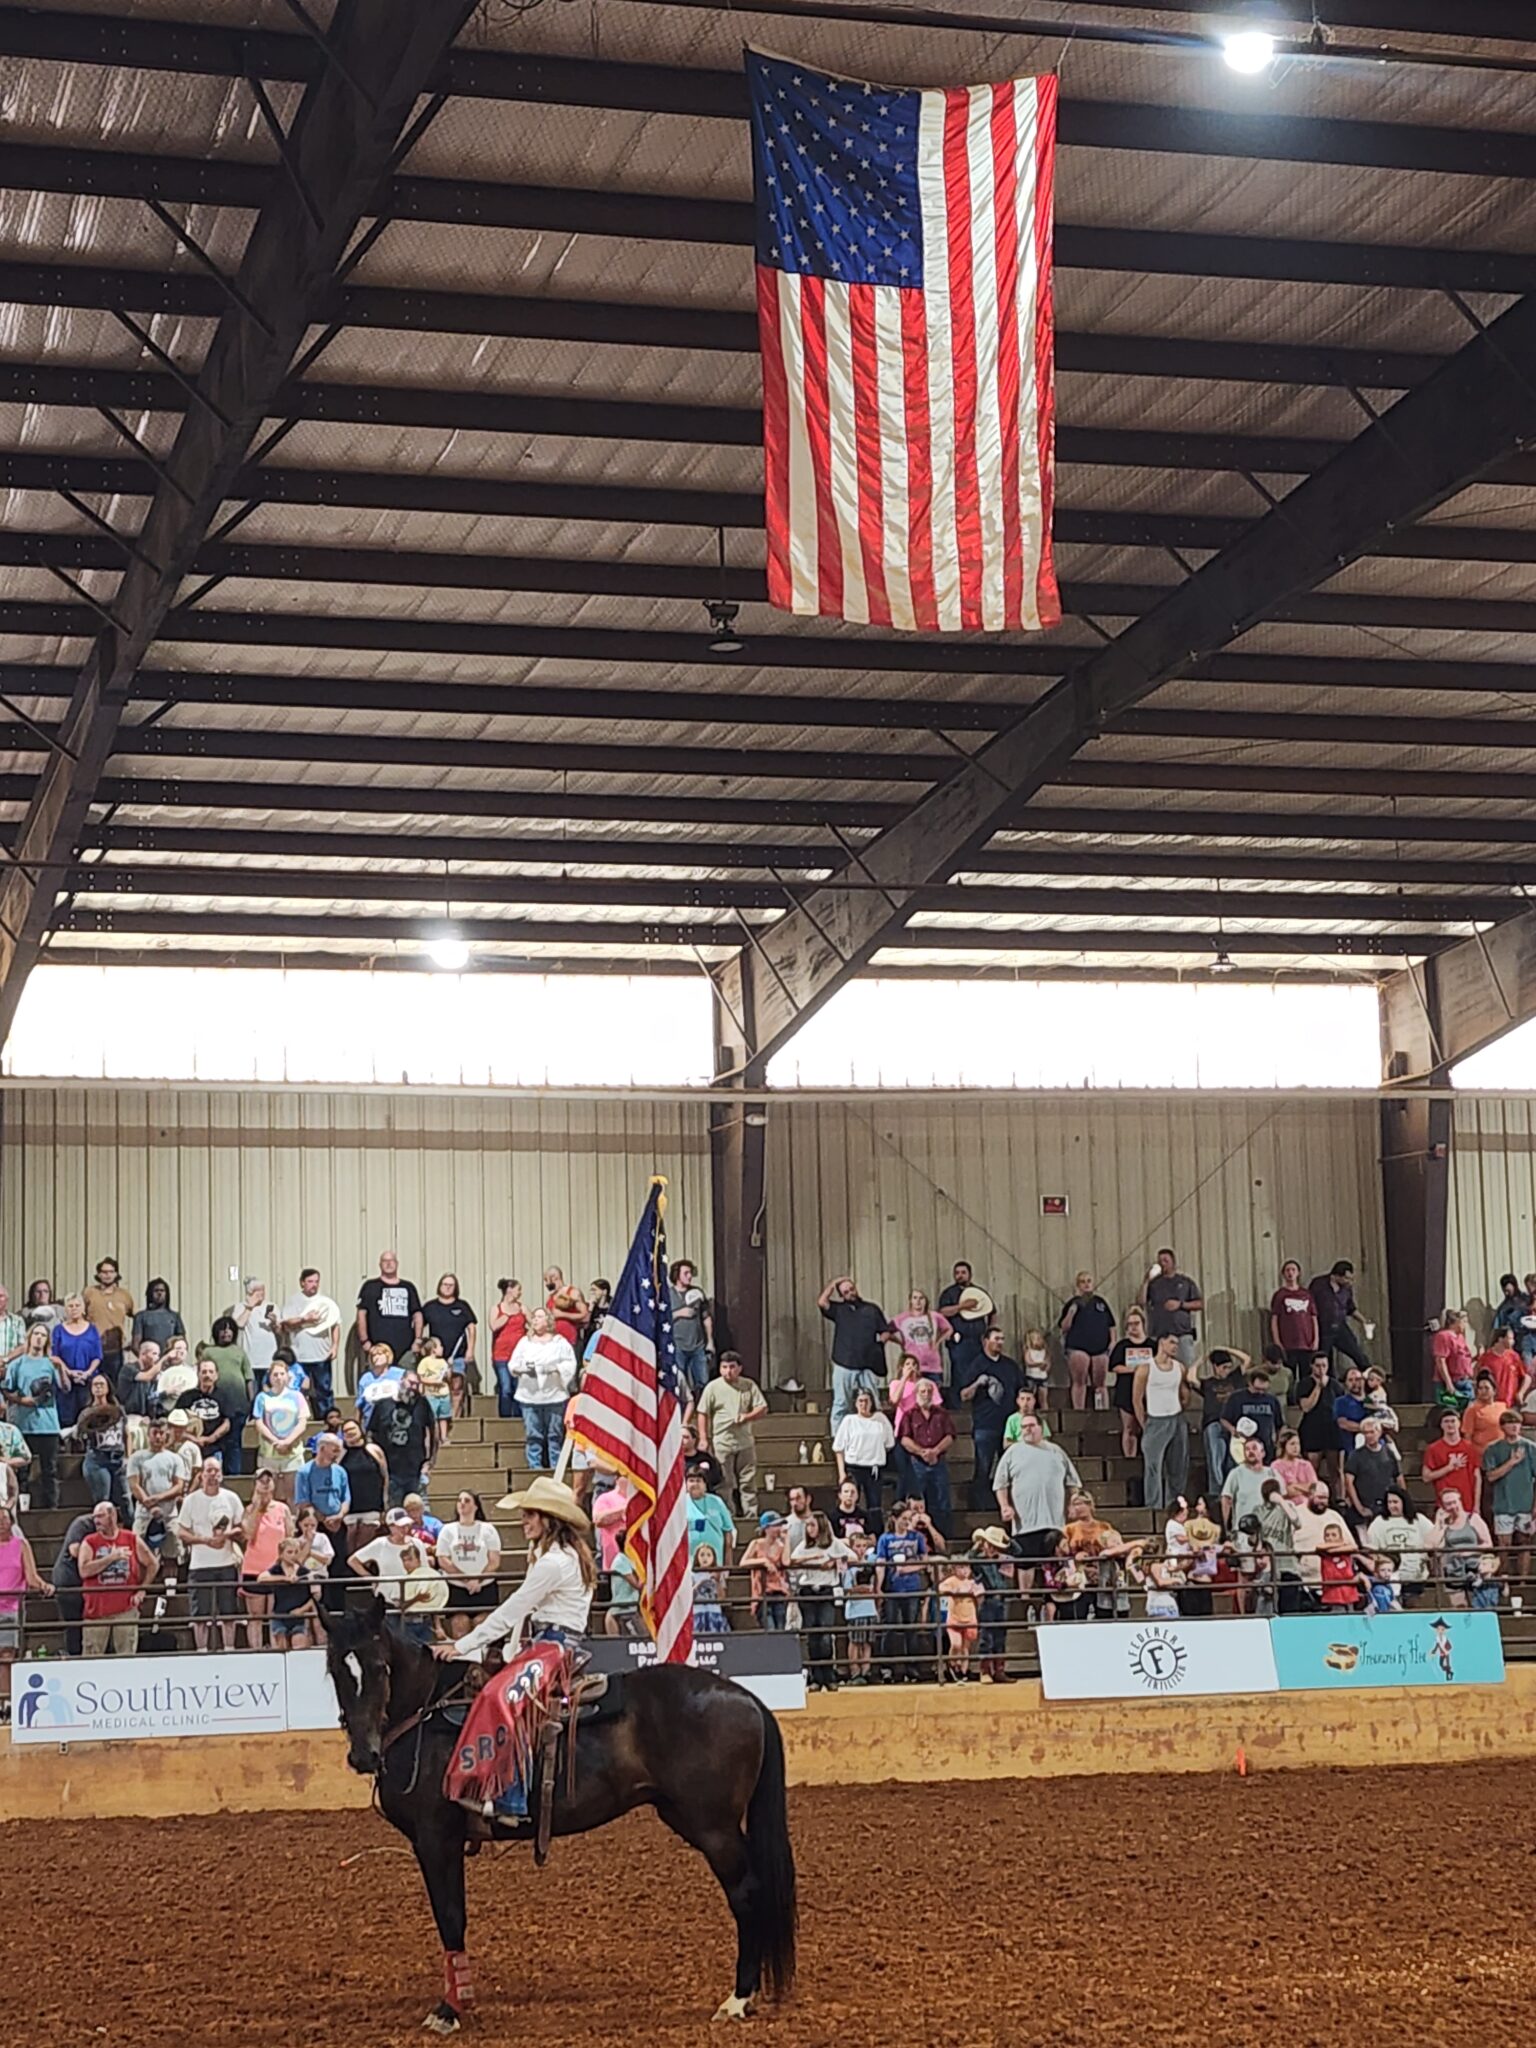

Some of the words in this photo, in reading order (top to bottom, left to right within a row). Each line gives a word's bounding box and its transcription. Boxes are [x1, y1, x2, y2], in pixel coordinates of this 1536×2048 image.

[1147, 1645, 1163, 1675] F
[76, 1675, 279, 1715] Southview
[92, 1716, 156, 1729] MEDICAL
[162, 1714, 210, 1726] CLINIC
